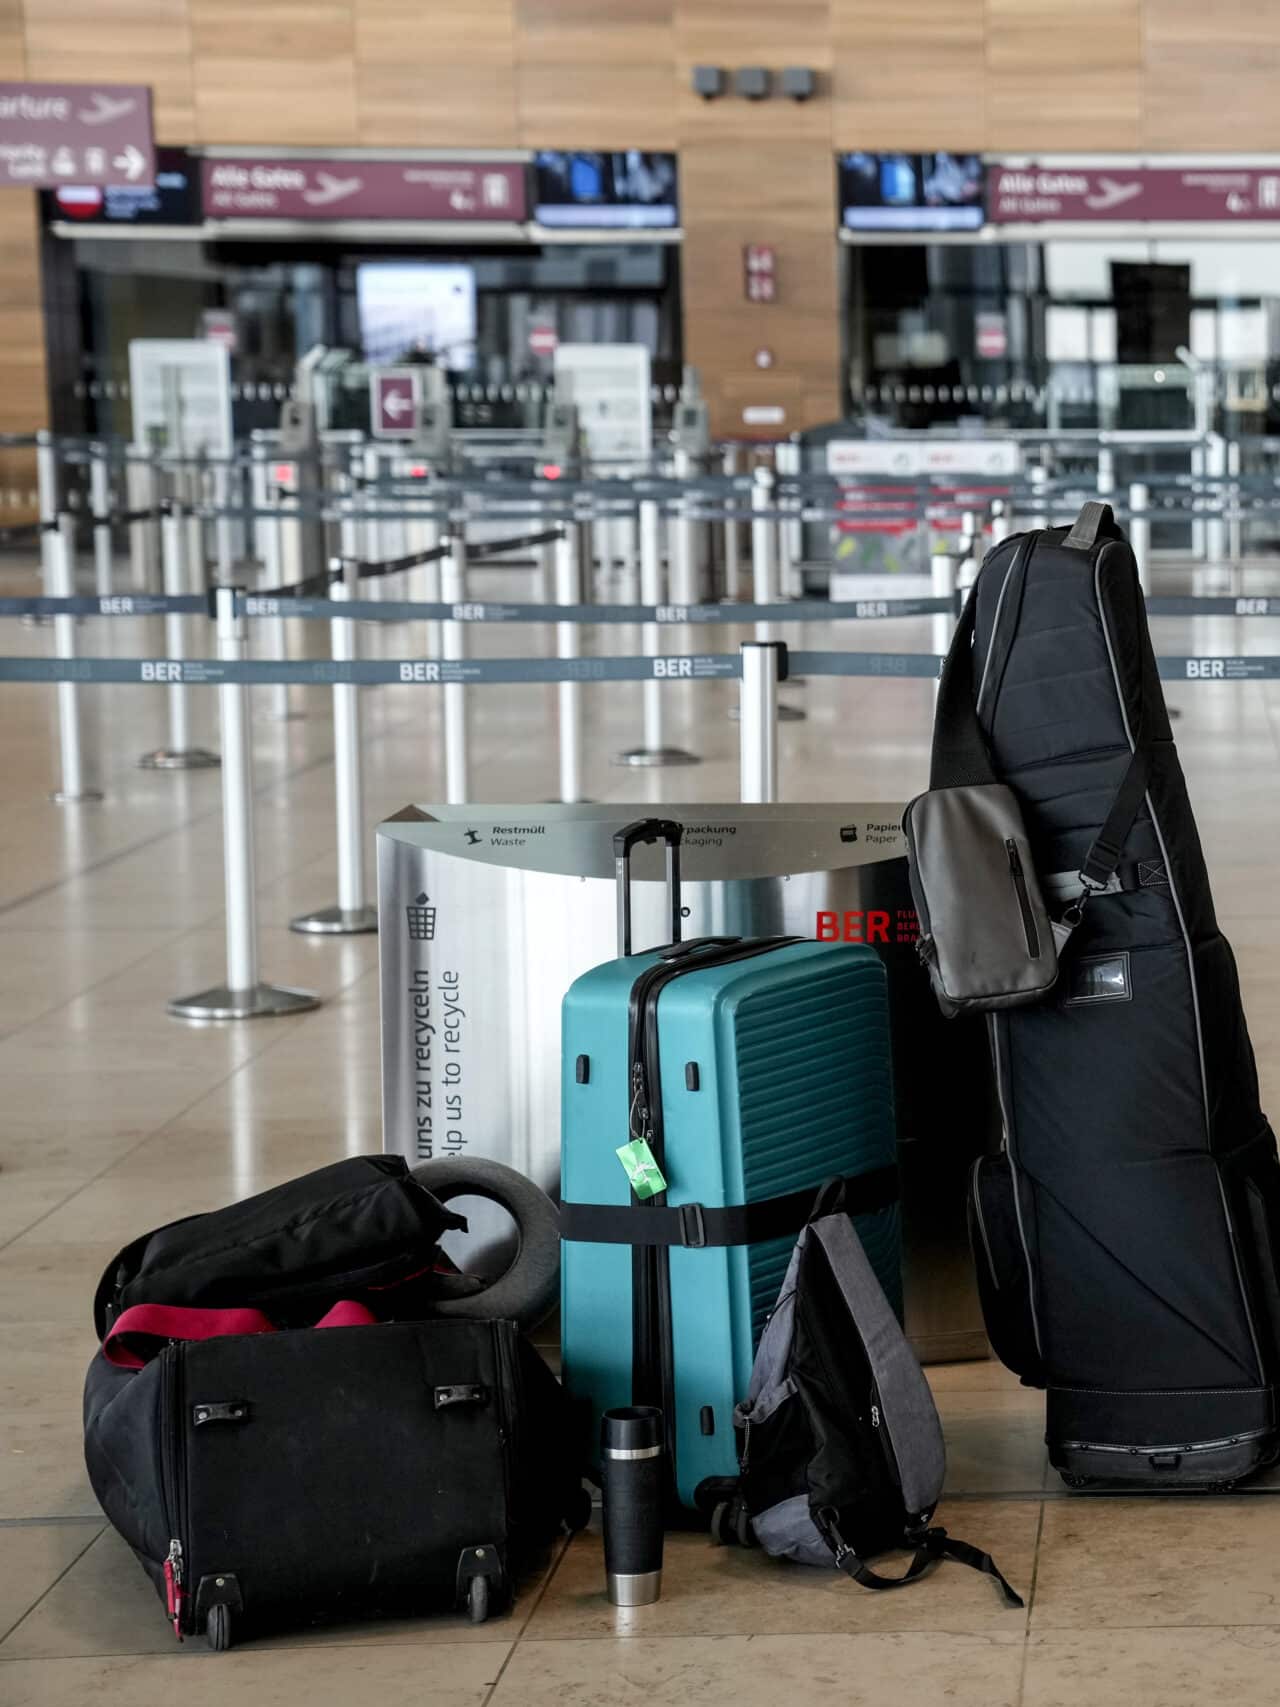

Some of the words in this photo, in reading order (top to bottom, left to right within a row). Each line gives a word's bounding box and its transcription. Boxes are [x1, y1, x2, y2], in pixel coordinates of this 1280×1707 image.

[999, 173, 1034, 194] Alle
[1036, 173, 1088, 195] Gates
[101, 597, 134, 613] BER
[246, 598, 279, 614] BER
[452, 605, 484, 620] BER
[655, 606, 687, 622] BER
[856, 602, 888, 617] BER
[1235, 598, 1268, 614] BER
[141, 662, 182, 681] BER
[400, 662, 439, 681] BER
[653, 658, 692, 677] BER
[1186, 659, 1224, 678] BER
[492, 826, 545, 834] Restmüll
[682, 825, 737, 834] rpackung
[865, 834, 897, 843] Paper
[490, 838, 526, 846] Waste
[680, 838, 723, 846] ckaging
[816, 911, 890, 943] BER
[408, 969, 436, 1071] recyceln
[437, 970, 466, 1053] recycle
[441, 1062, 461, 1087] to
[415, 1080, 432, 1109] zu
[445, 1094, 462, 1121] us
[416, 1115, 433, 1160] uns
